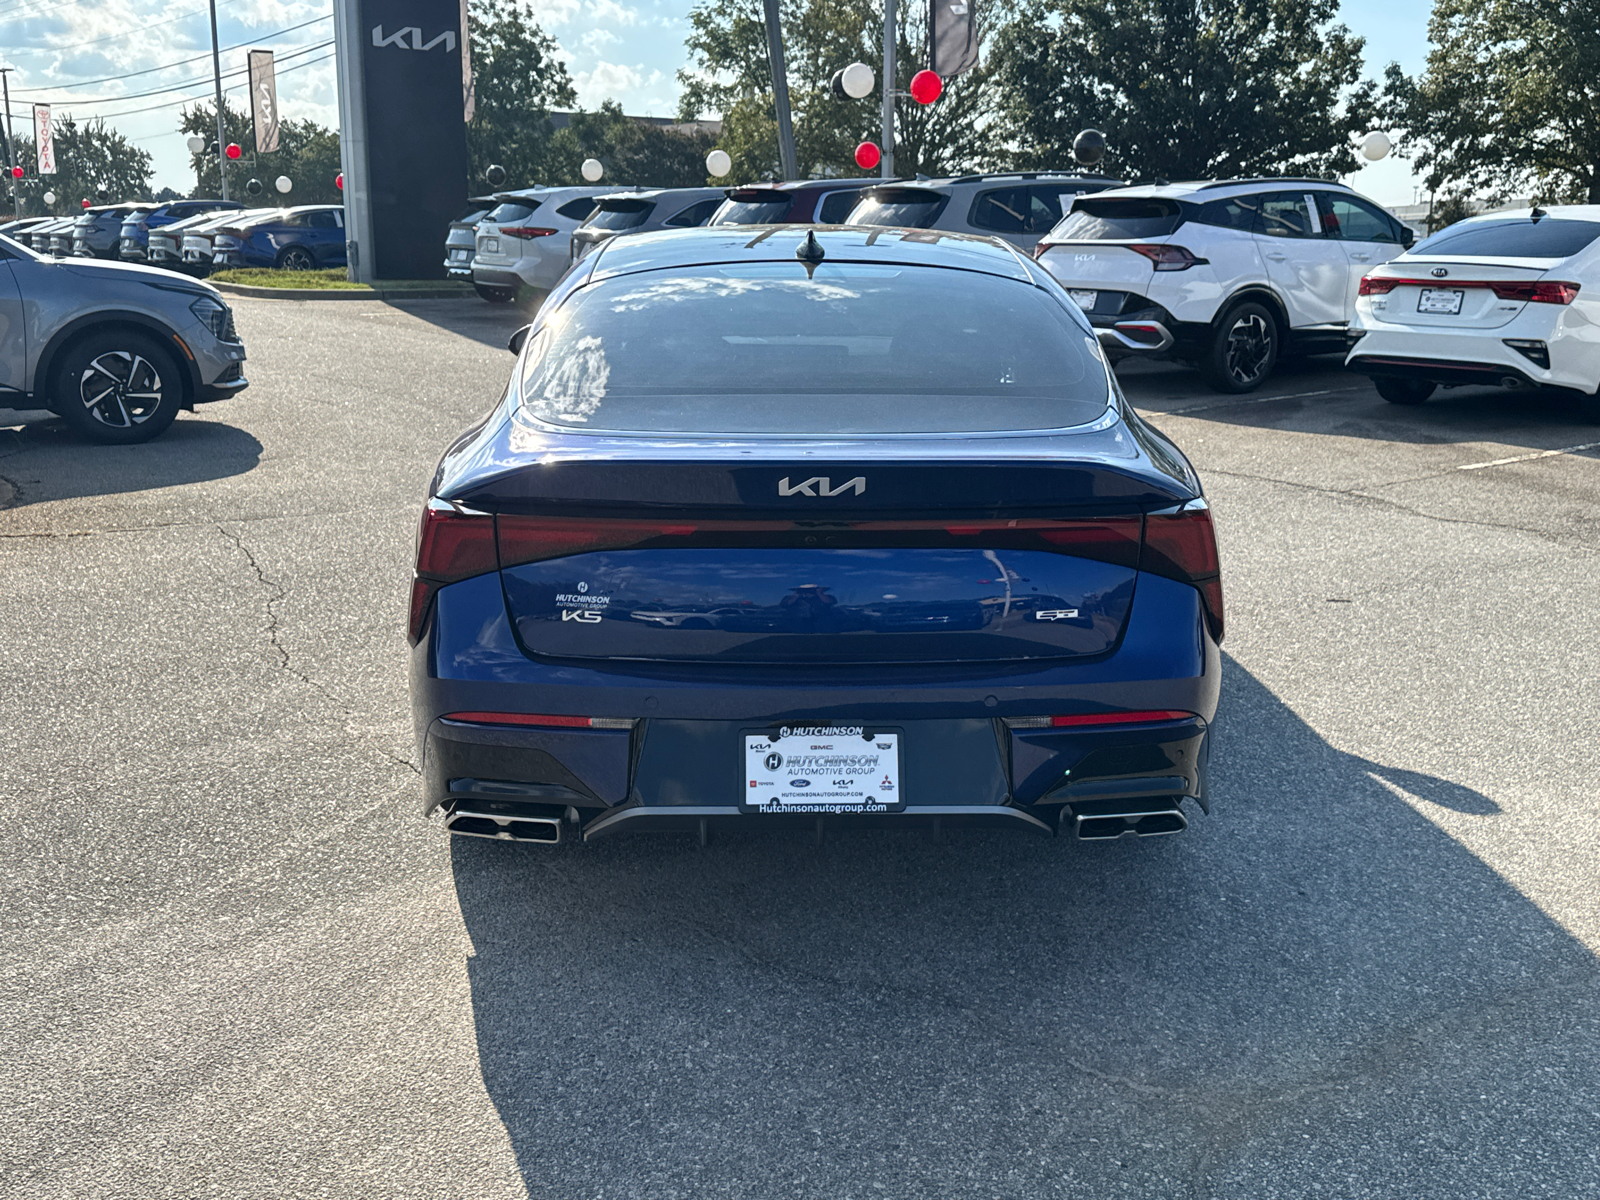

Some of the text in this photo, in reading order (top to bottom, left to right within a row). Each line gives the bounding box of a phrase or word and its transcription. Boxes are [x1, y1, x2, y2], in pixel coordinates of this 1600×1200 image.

[372, 24, 456, 53] KIA
[41, 120, 51, 169] TOYOTA
[1074, 253, 1096, 261] KIA
[778, 476, 866, 496] KIA
[555, 594, 610, 603] HUTCHINSON
[562, 609, 602, 623] K5
[792, 726, 864, 736] HUTCHINSON
[785, 754, 880, 768] HUTCHINSON
[787, 767, 876, 776] AUTOMOTIVE GROUP
[759, 803, 887, 814] Hutchinsonautogroup.com
